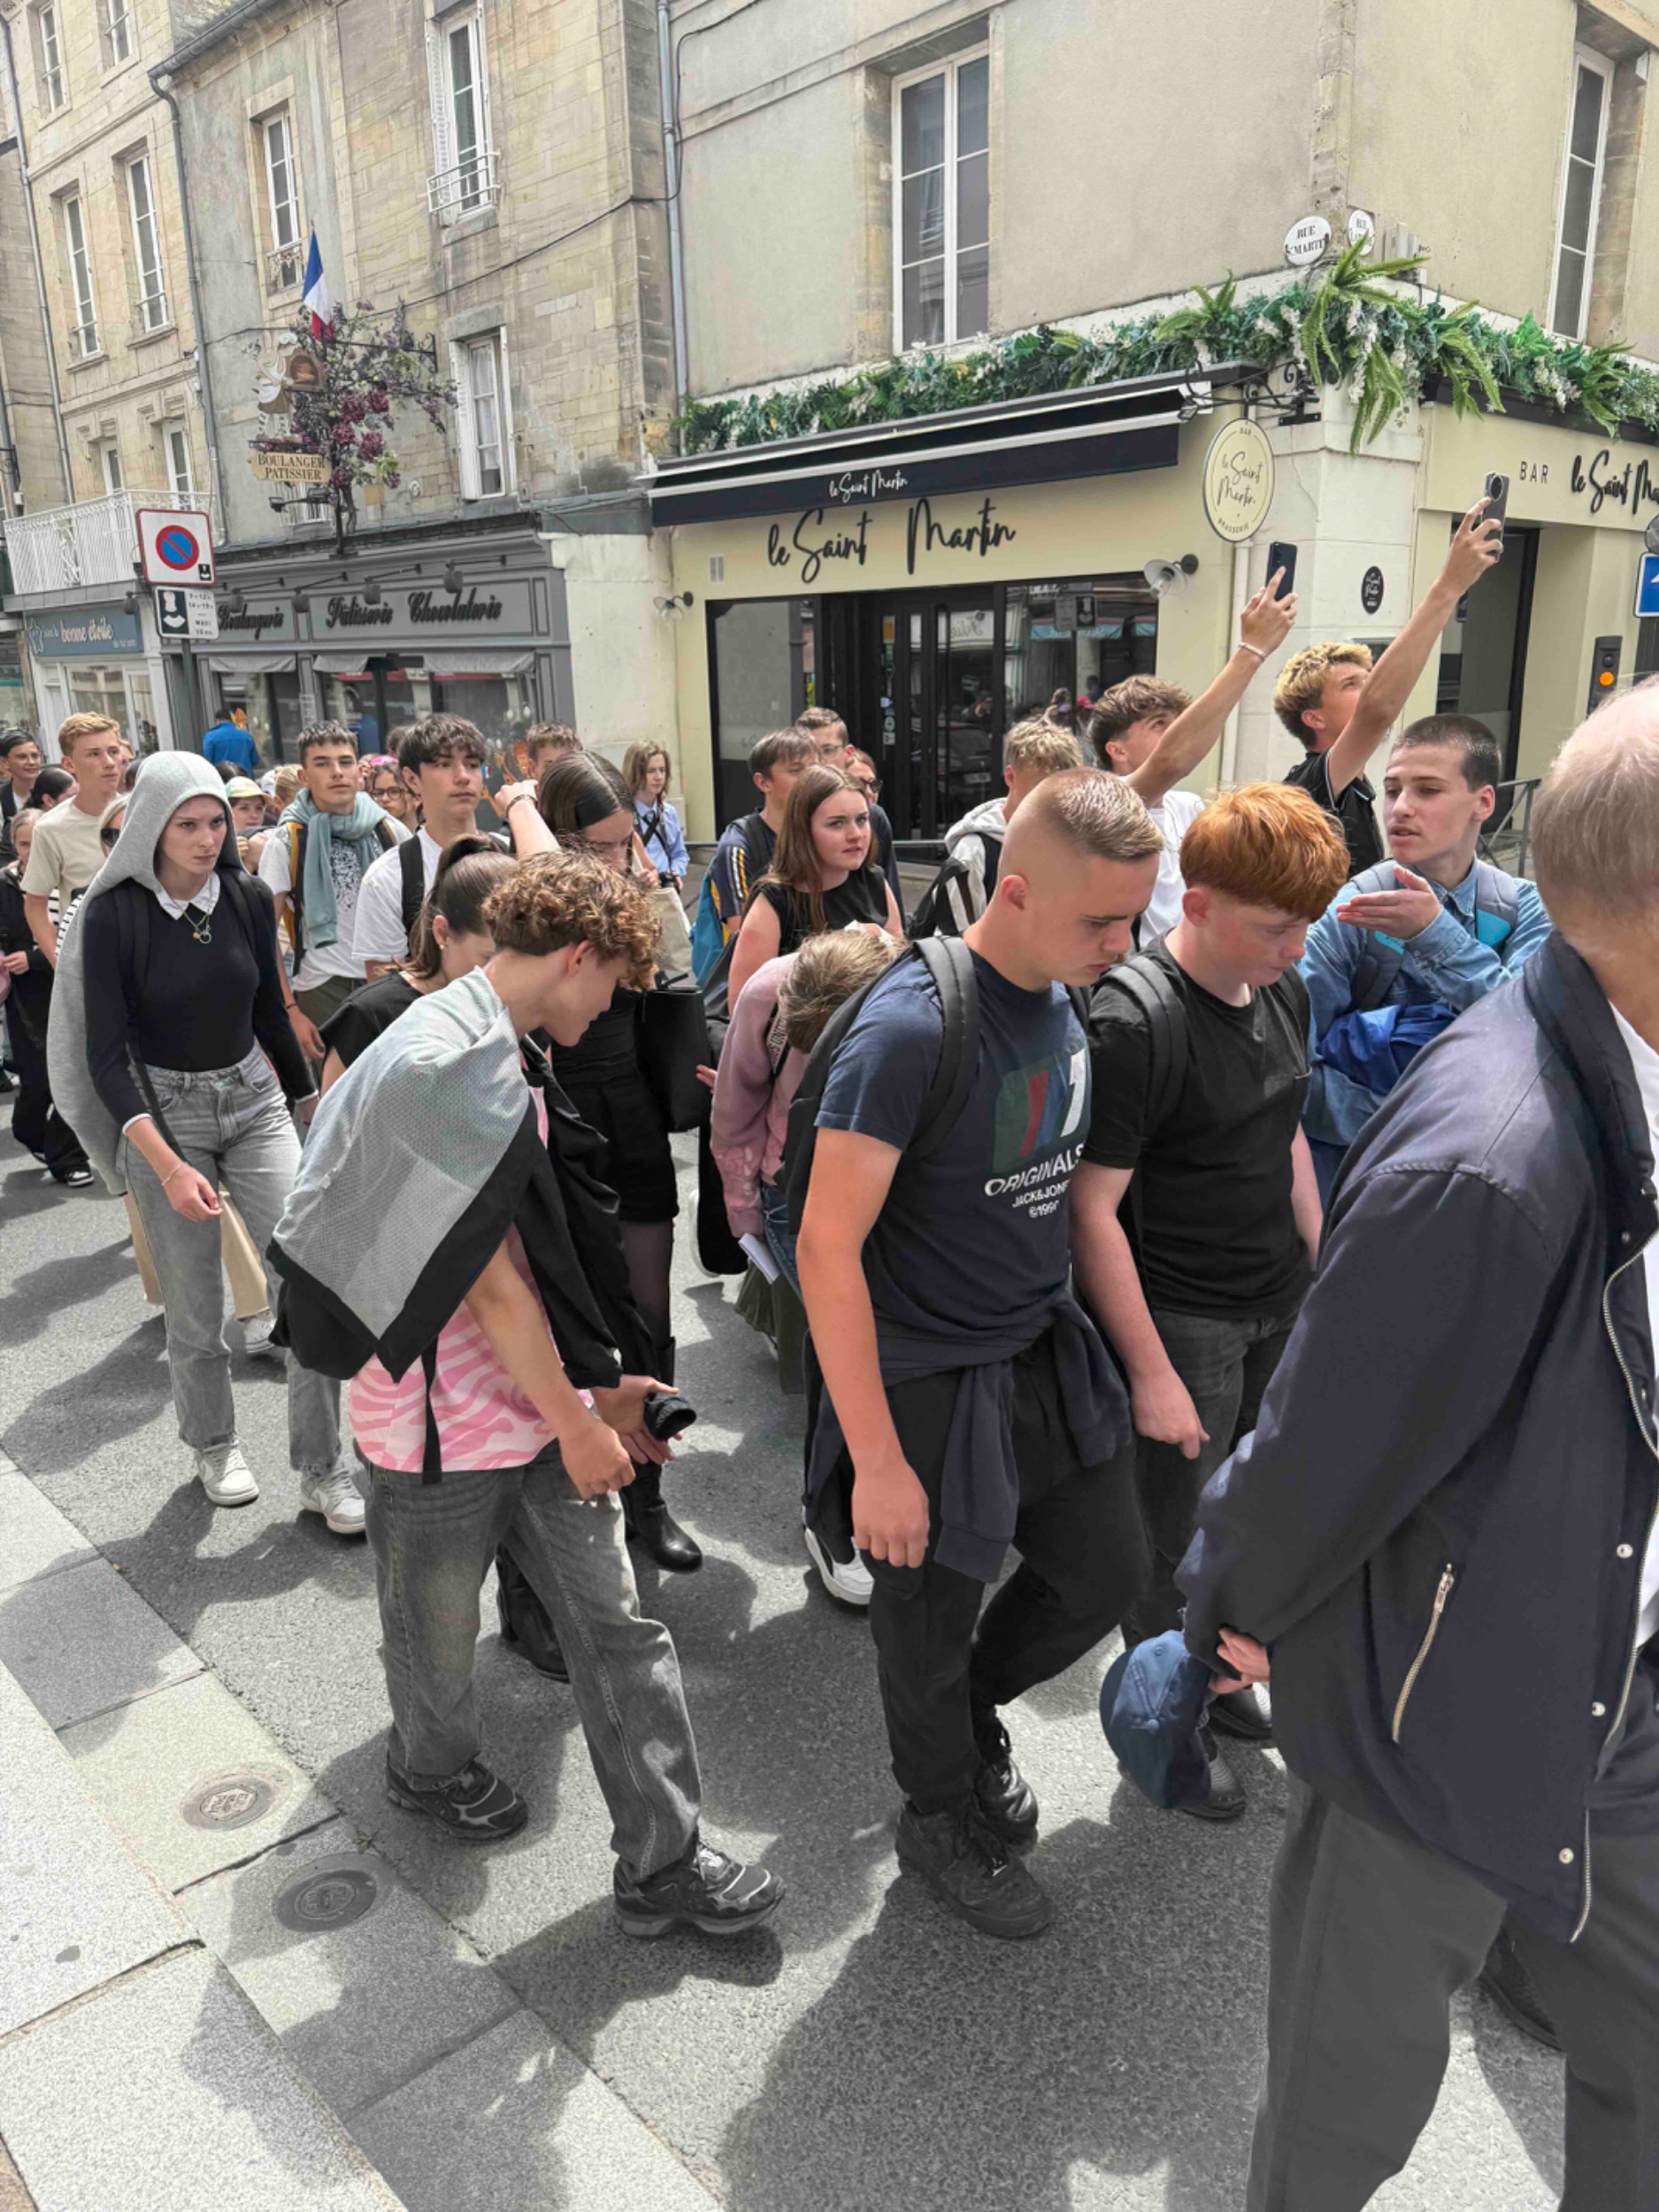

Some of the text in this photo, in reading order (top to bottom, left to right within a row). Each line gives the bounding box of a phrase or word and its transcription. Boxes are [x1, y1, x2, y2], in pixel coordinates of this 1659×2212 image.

[1297, 225, 1316, 240] RUE
[257, 454, 326, 469] BOULANGER
[1231, 450, 1263, 486] Saint
[829, 469, 908, 503] le Saint Martin
[1217, 475, 1256, 507] Martin
[1519, 461, 1548, 484] BAR
[1571, 455, 1586, 494] le
[1589, 449, 1632, 513] Saint
[768, 497, 1017, 584] le Saint Martin
[408, 587, 503, 623] Chocolaterie
[985, 1142, 1085, 1196] ORIGINALS
